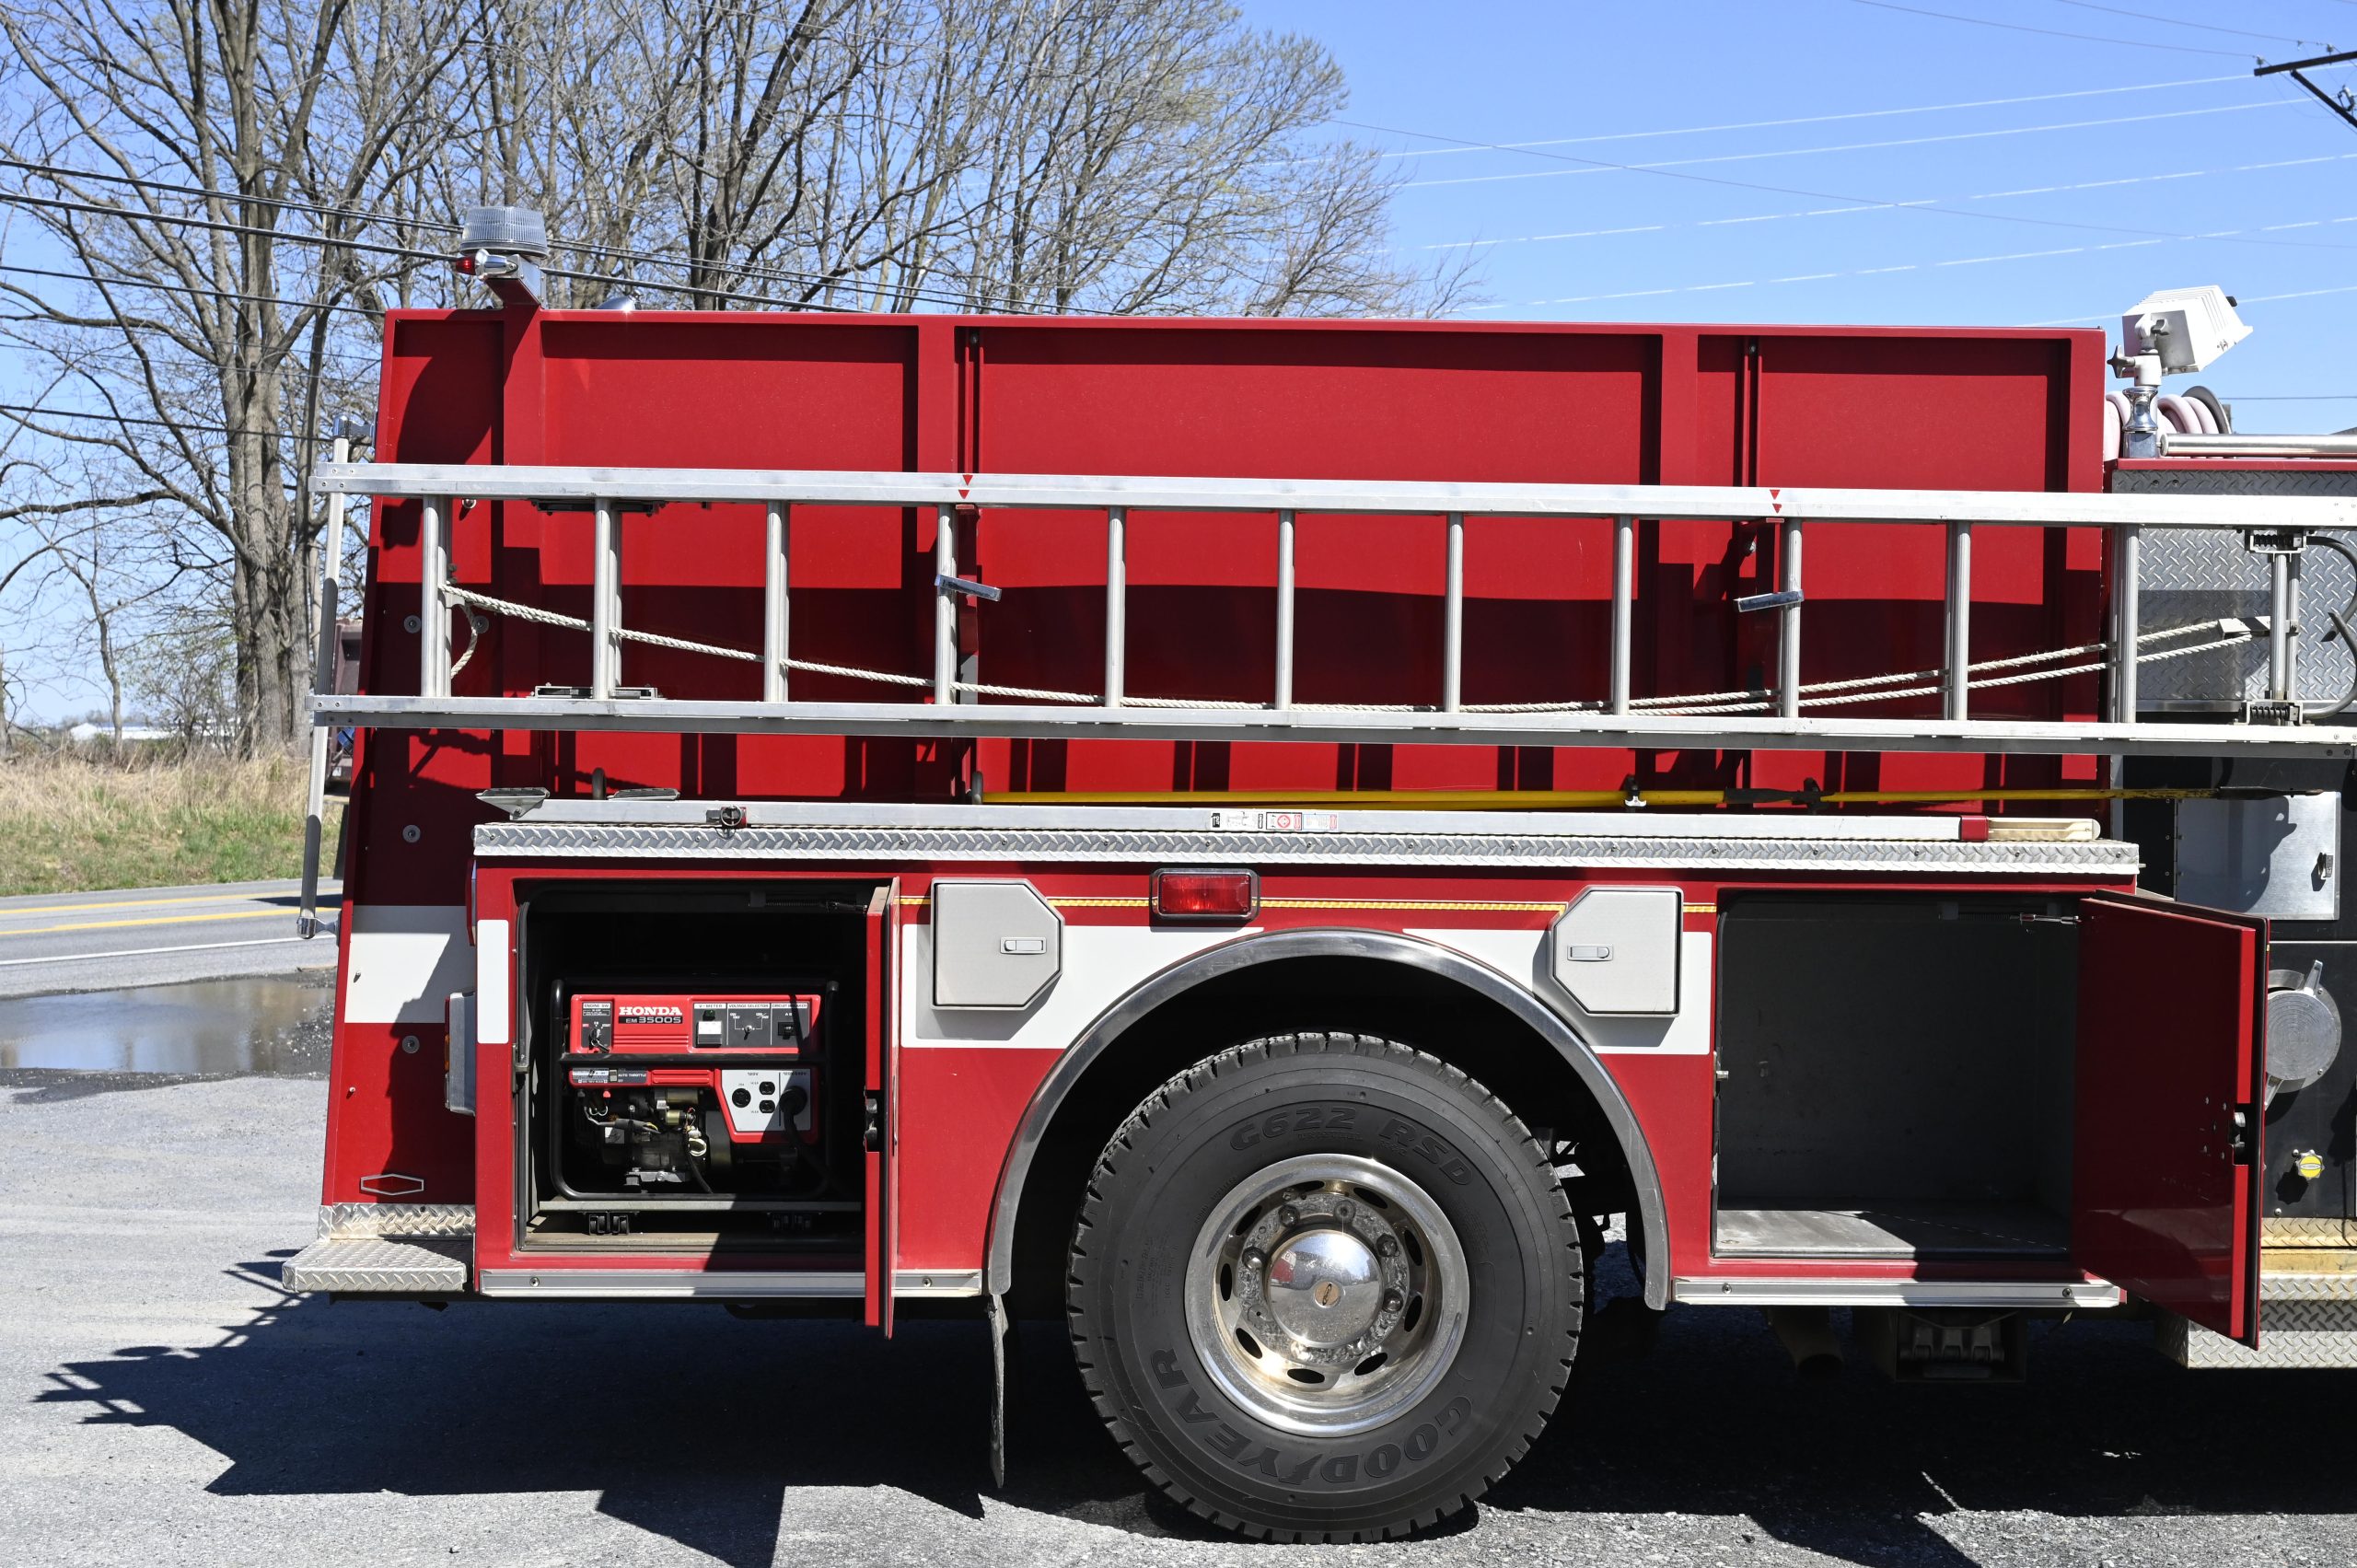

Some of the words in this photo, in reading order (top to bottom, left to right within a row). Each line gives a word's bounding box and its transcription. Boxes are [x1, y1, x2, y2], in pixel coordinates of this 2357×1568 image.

[619, 1006, 682, 1016] HONDA
[1229, 1106, 1357, 1150] G622
[1377, 1117, 1473, 1186] RSD
[1151, 1347, 1473, 1486] GOODYEAR
